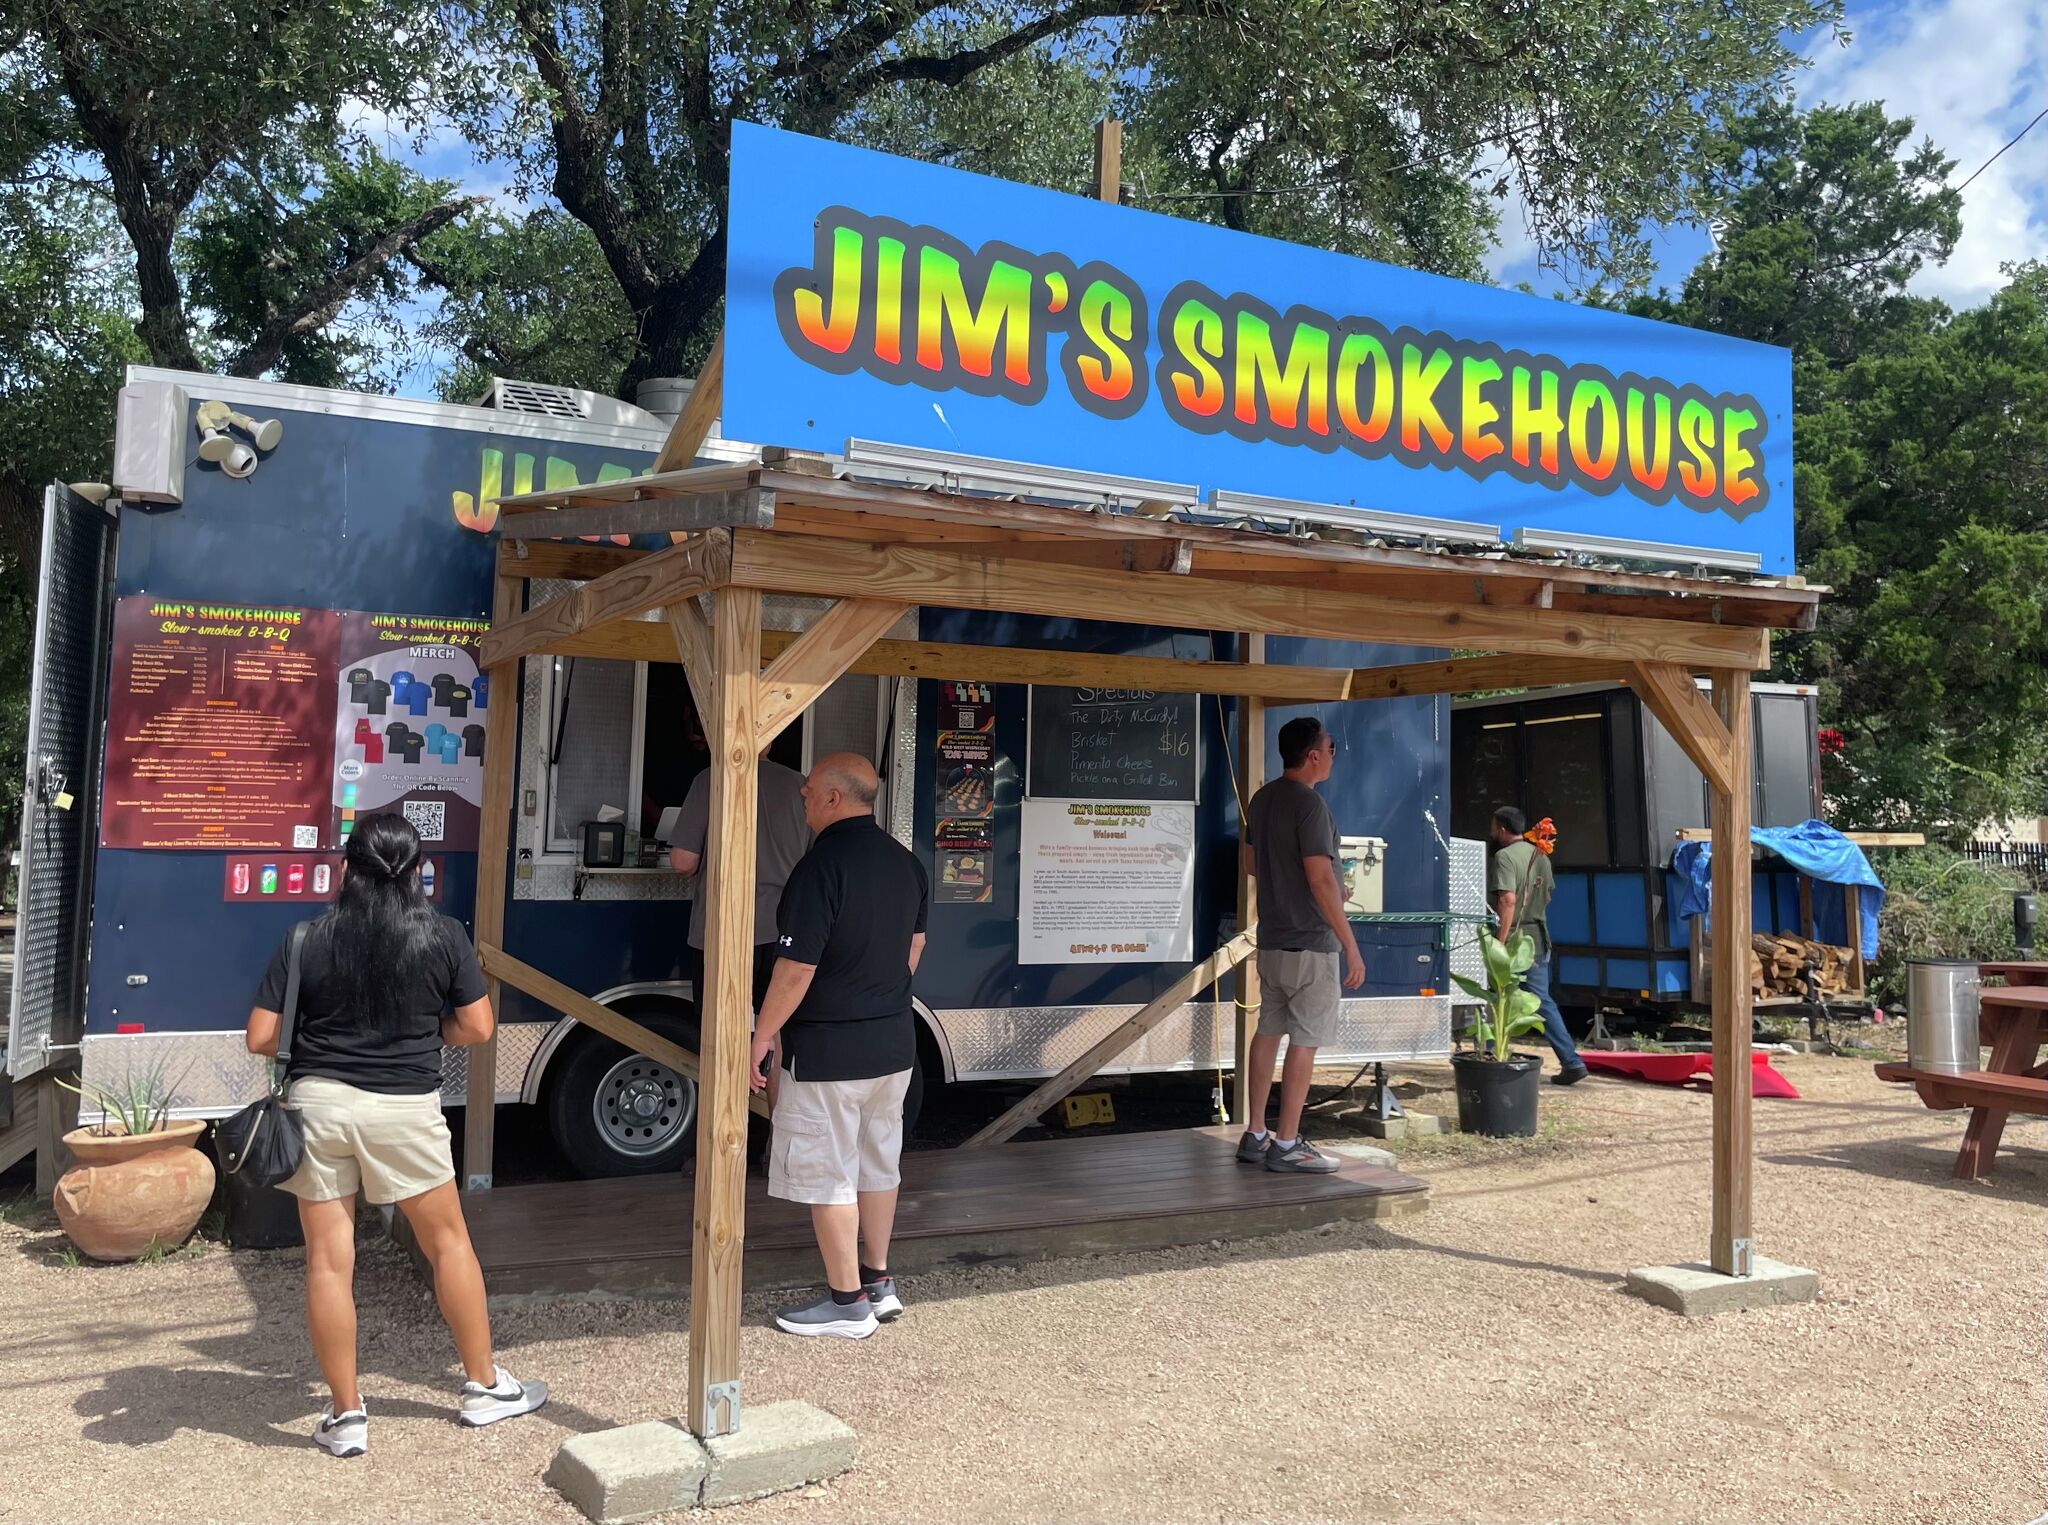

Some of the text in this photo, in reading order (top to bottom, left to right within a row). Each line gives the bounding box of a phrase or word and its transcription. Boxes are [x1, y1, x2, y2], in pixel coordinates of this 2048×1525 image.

[793, 225, 1760, 507] JIM'S SMOKEHOUSE
[150, 603, 301, 625] JIM'S SMOKEHOUSE
[372, 616, 492, 633] JIM'S SMOKEHOUSE
[248, 625, 290, 642] B-B-Q
[409, 647, 456, 660] MERCH
[1068, 711, 1088, 724] The
[1072, 732, 1117, 748] Brisket
[1158, 728, 1190, 757] $16
[1071, 750, 1111, 770] Pimento
[438, 776, 470, 784] Scanning
[1070, 771, 1098, 784] Pickle
[1158, 772, 1178, 787] Bun
[1068, 804, 1152, 816] JIM'S SMOKEHOUSE
[1092, 830, 1127, 840] Welcome!
